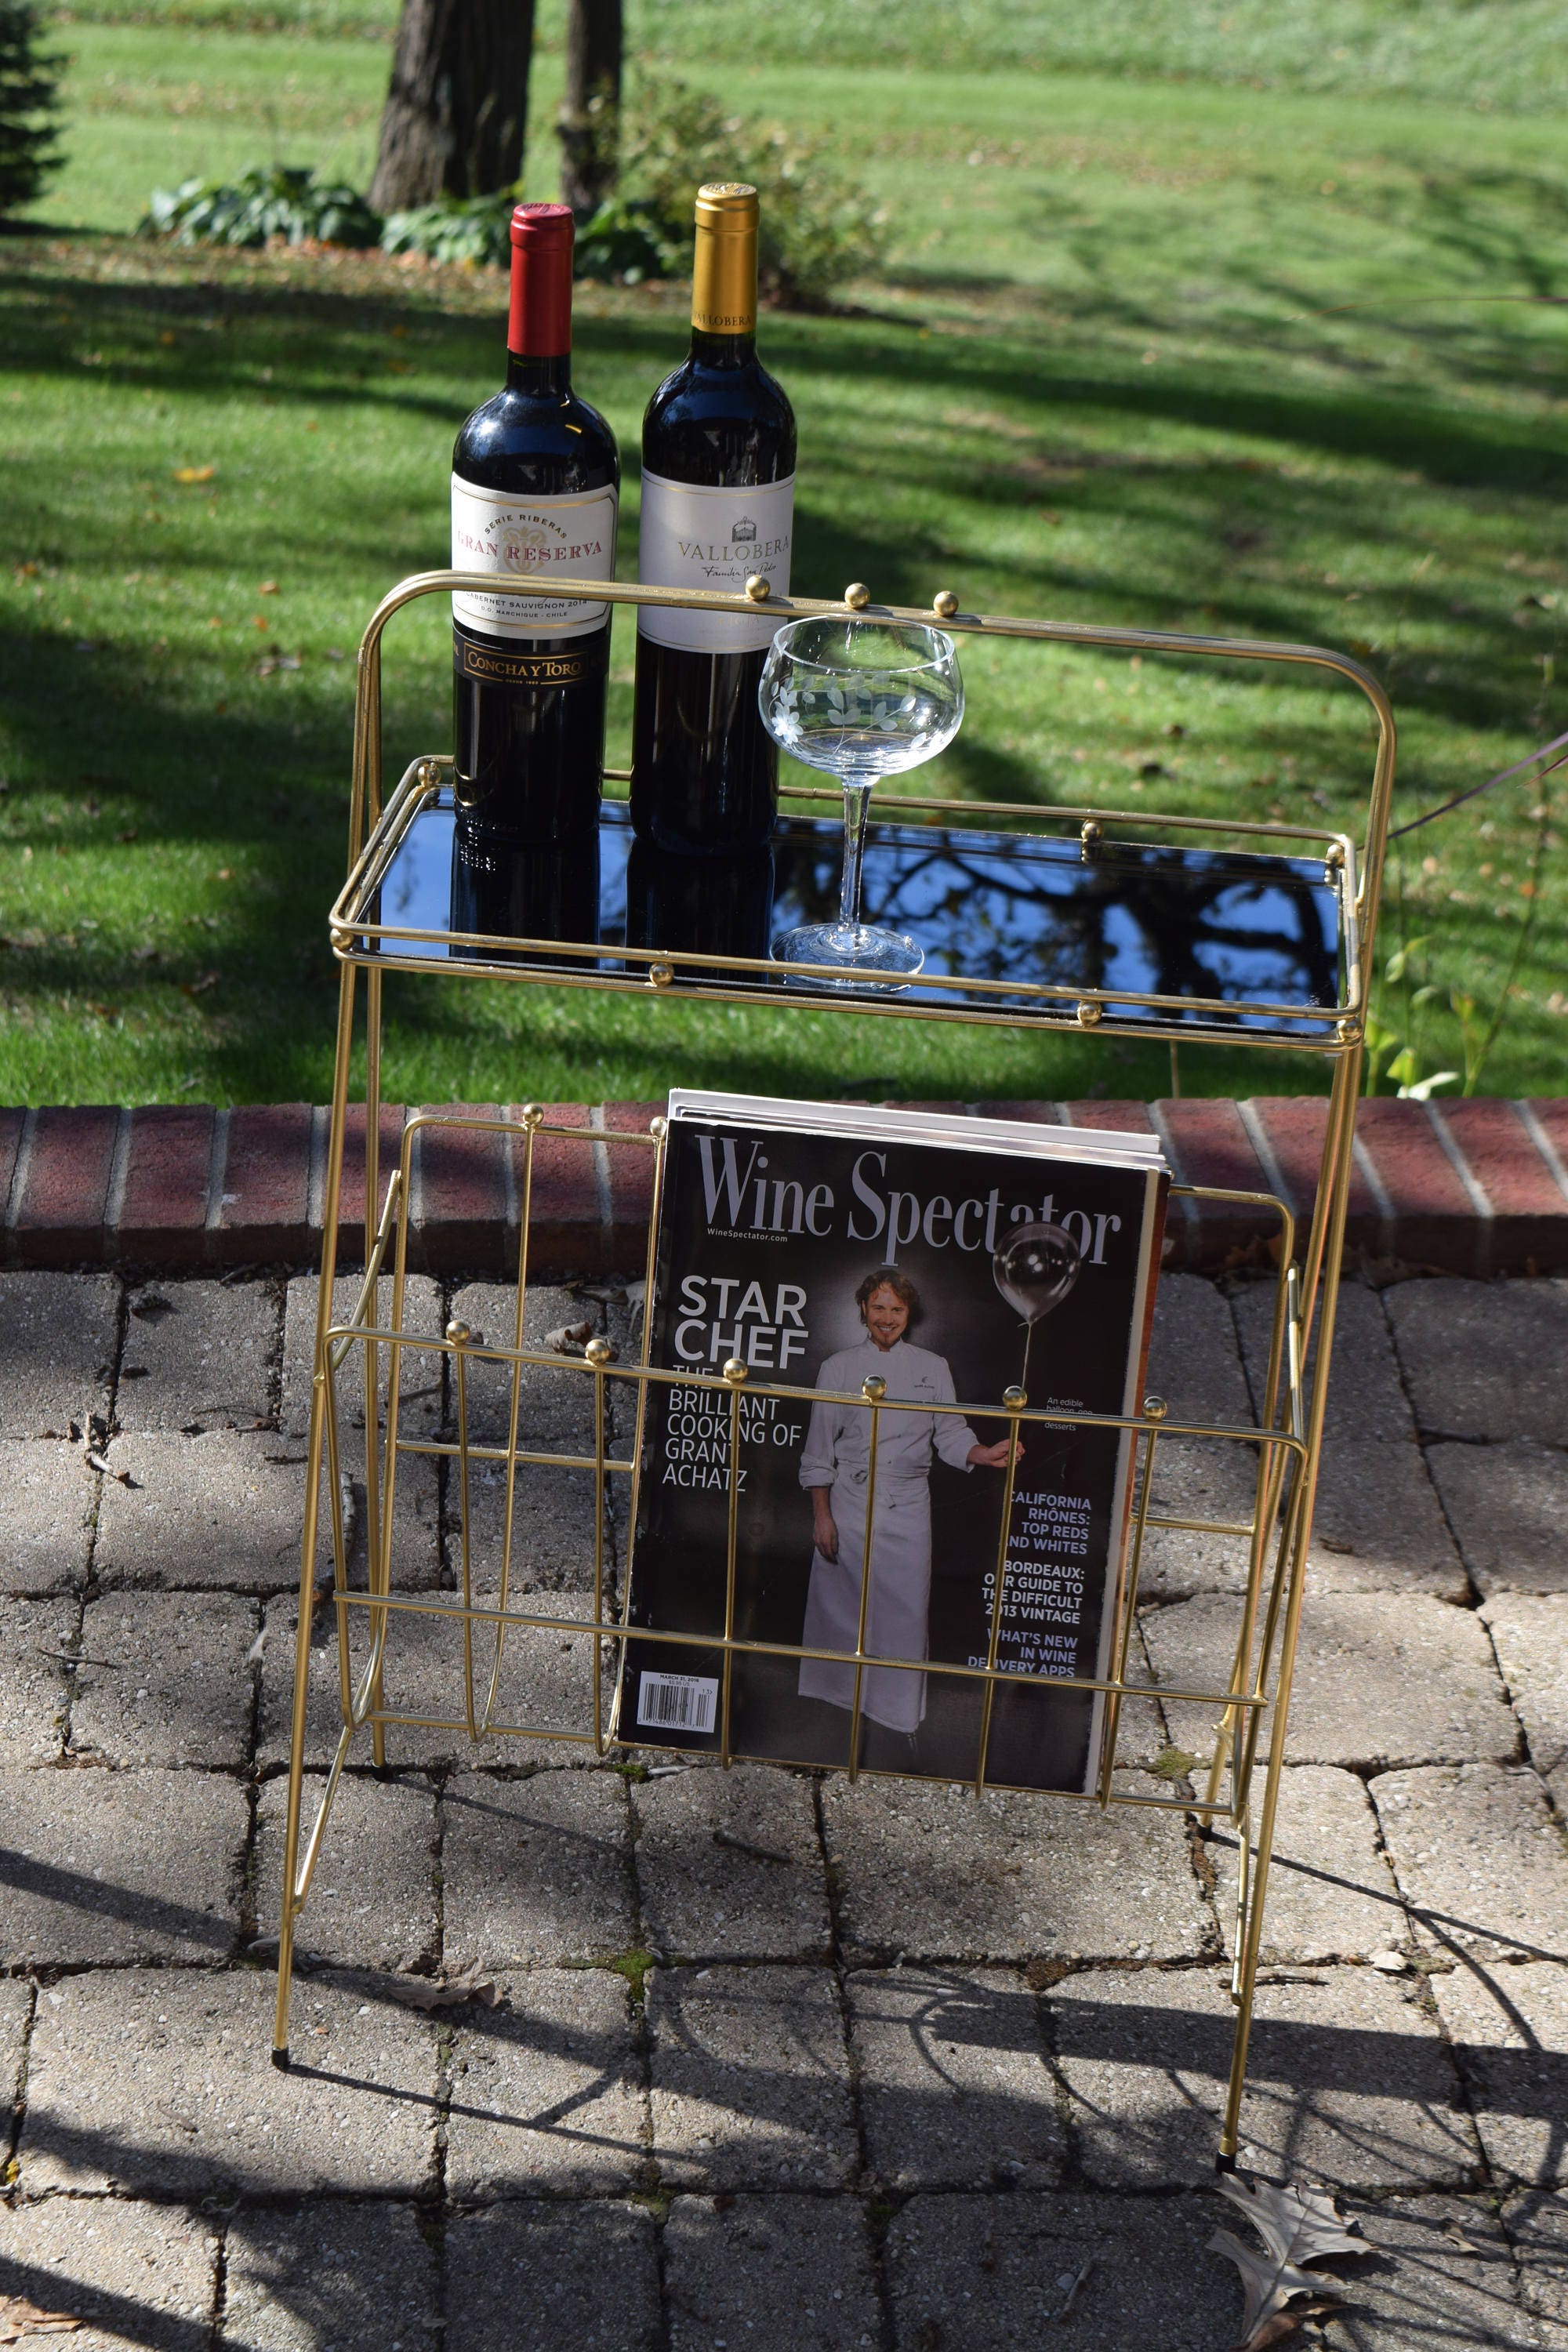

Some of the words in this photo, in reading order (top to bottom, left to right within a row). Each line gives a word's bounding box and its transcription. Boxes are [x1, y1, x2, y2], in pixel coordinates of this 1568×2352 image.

[694, 312, 751, 326] ALLOBERA
[485, 514, 514, 534] SERIE
[519, 514, 567, 539] RIBERAS
[506, 541, 602, 561] RESERVA
[677, 535, 789, 561] VALLOBERA
[467, 652, 528, 677] CONCHA
[530, 666, 542, 677] Y
[542, 661, 582, 677] TORO
[694, 1134, 835, 1236] Wine
[706, 1227, 788, 1243] WineSpectator.com
[677, 1274, 808, 1327] STAR
[673, 1319, 809, 1370] CHEF
[668, 1388, 781, 1421] BRILLIANT
[1047, 1396, 1058, 1405] An
[1059, 1398, 1083, 1407] edible
[667, 1413, 766, 1444] COOKING
[772, 1423, 803, 1447] OF
[1044, 1421, 1077, 1432] desserts
[665, 1437, 741, 1465] GRAN
[662, 1463, 748, 1493] ACHATZ
[1028, 1506, 1091, 1526] RHÔNES:
[1022, 1522, 1049, 1536] TOP
[1051, 1525, 1090, 1541] REDS
[998, 1535, 1030, 1548] ND
[1033, 1537, 1088, 1555] WHITES
[1004, 1559, 1086, 1580] BORDEAUX:
[984, 1573, 1014, 1588] OR
[1018, 1576, 1062, 1592] GUIDE
[1065, 1581, 1083, 1595] TO
[982, 1587, 1010, 1602] THE
[1011, 1590, 1083, 1610] DIFFICULT
[1020, 1605, 1081, 1624] VINTAGE
[986, 1628, 1041, 1645] WHAT'S
[1044, 1634, 1079, 1649] NEW
[1020, 1646, 1035, 1660] IN
[1038, 1648, 1078, 1664] WINE
[967, 1656, 1036, 1673] DEIVERY
[1038, 1664, 1076, 1678] APPS
